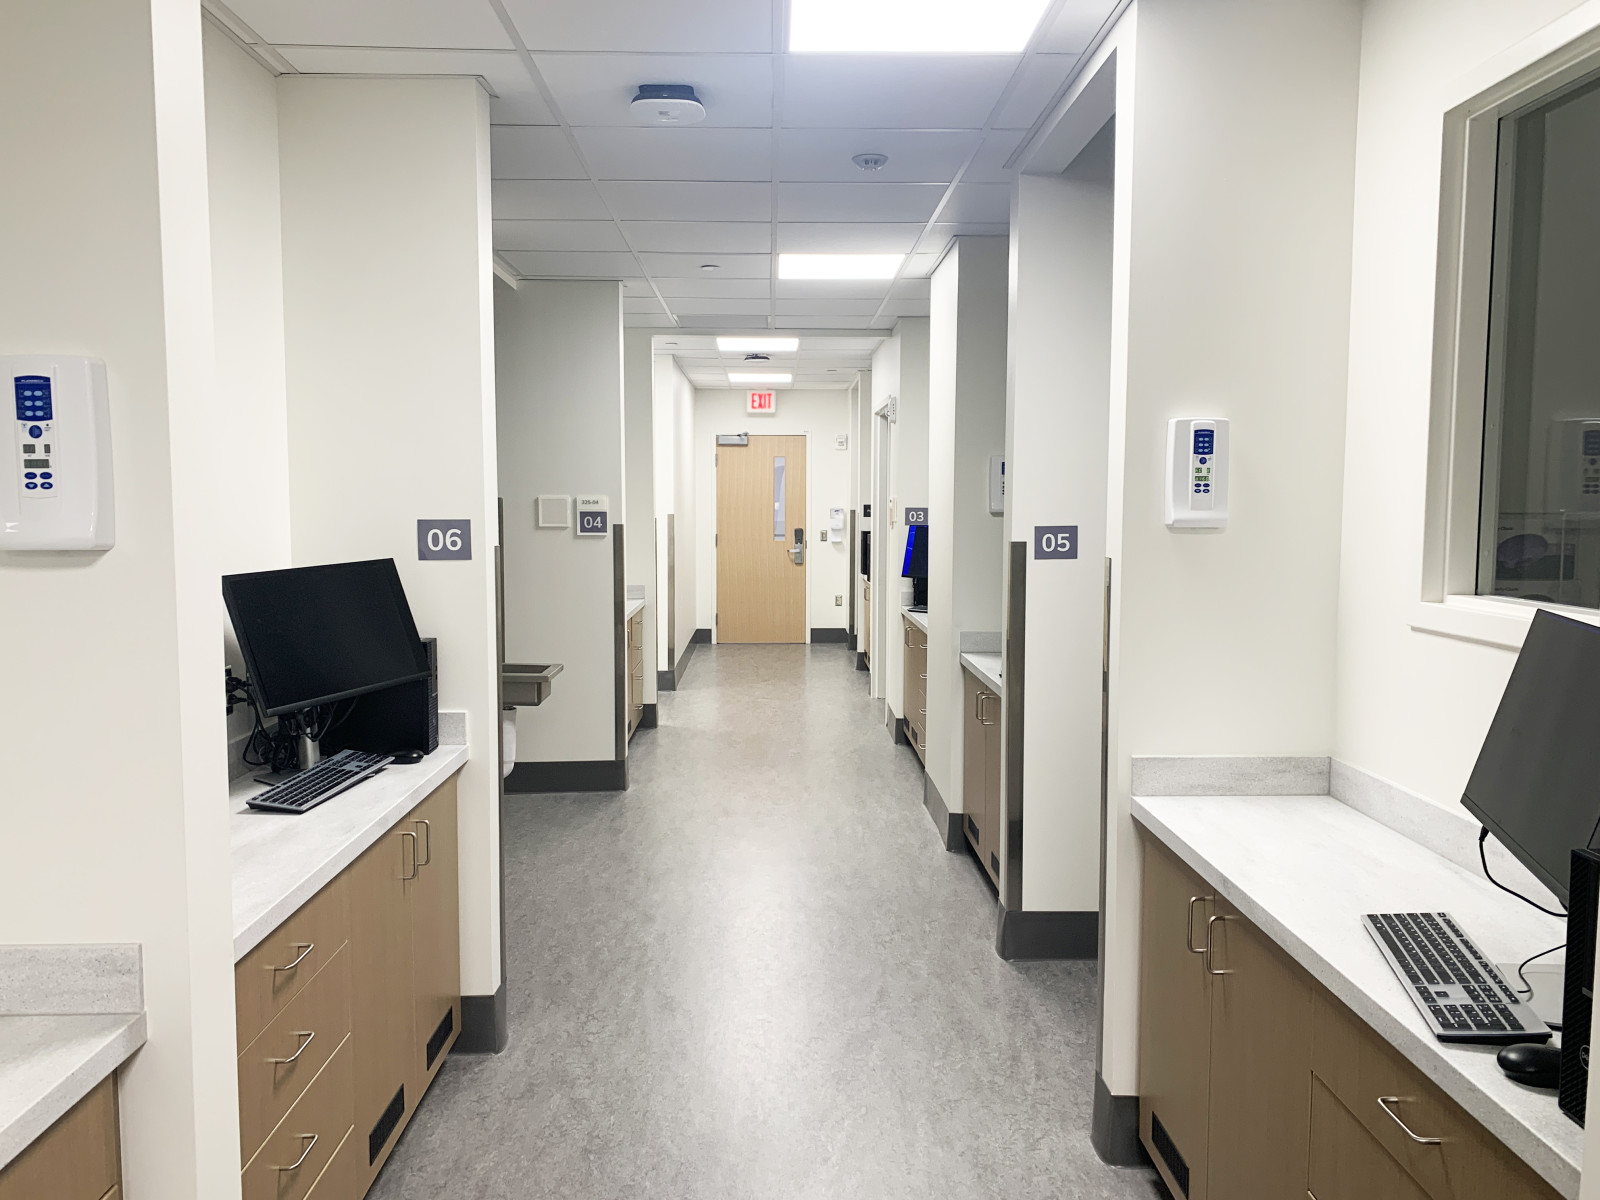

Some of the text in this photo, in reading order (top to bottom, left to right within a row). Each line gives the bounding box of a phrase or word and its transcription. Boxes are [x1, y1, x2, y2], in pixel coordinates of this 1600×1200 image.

[751, 393, 772, 409] EXIT
[584, 516, 602, 529] 04
[909, 511, 924, 522] 03
[427, 528, 462, 551] 06
[1042, 533, 1070, 552] 05
